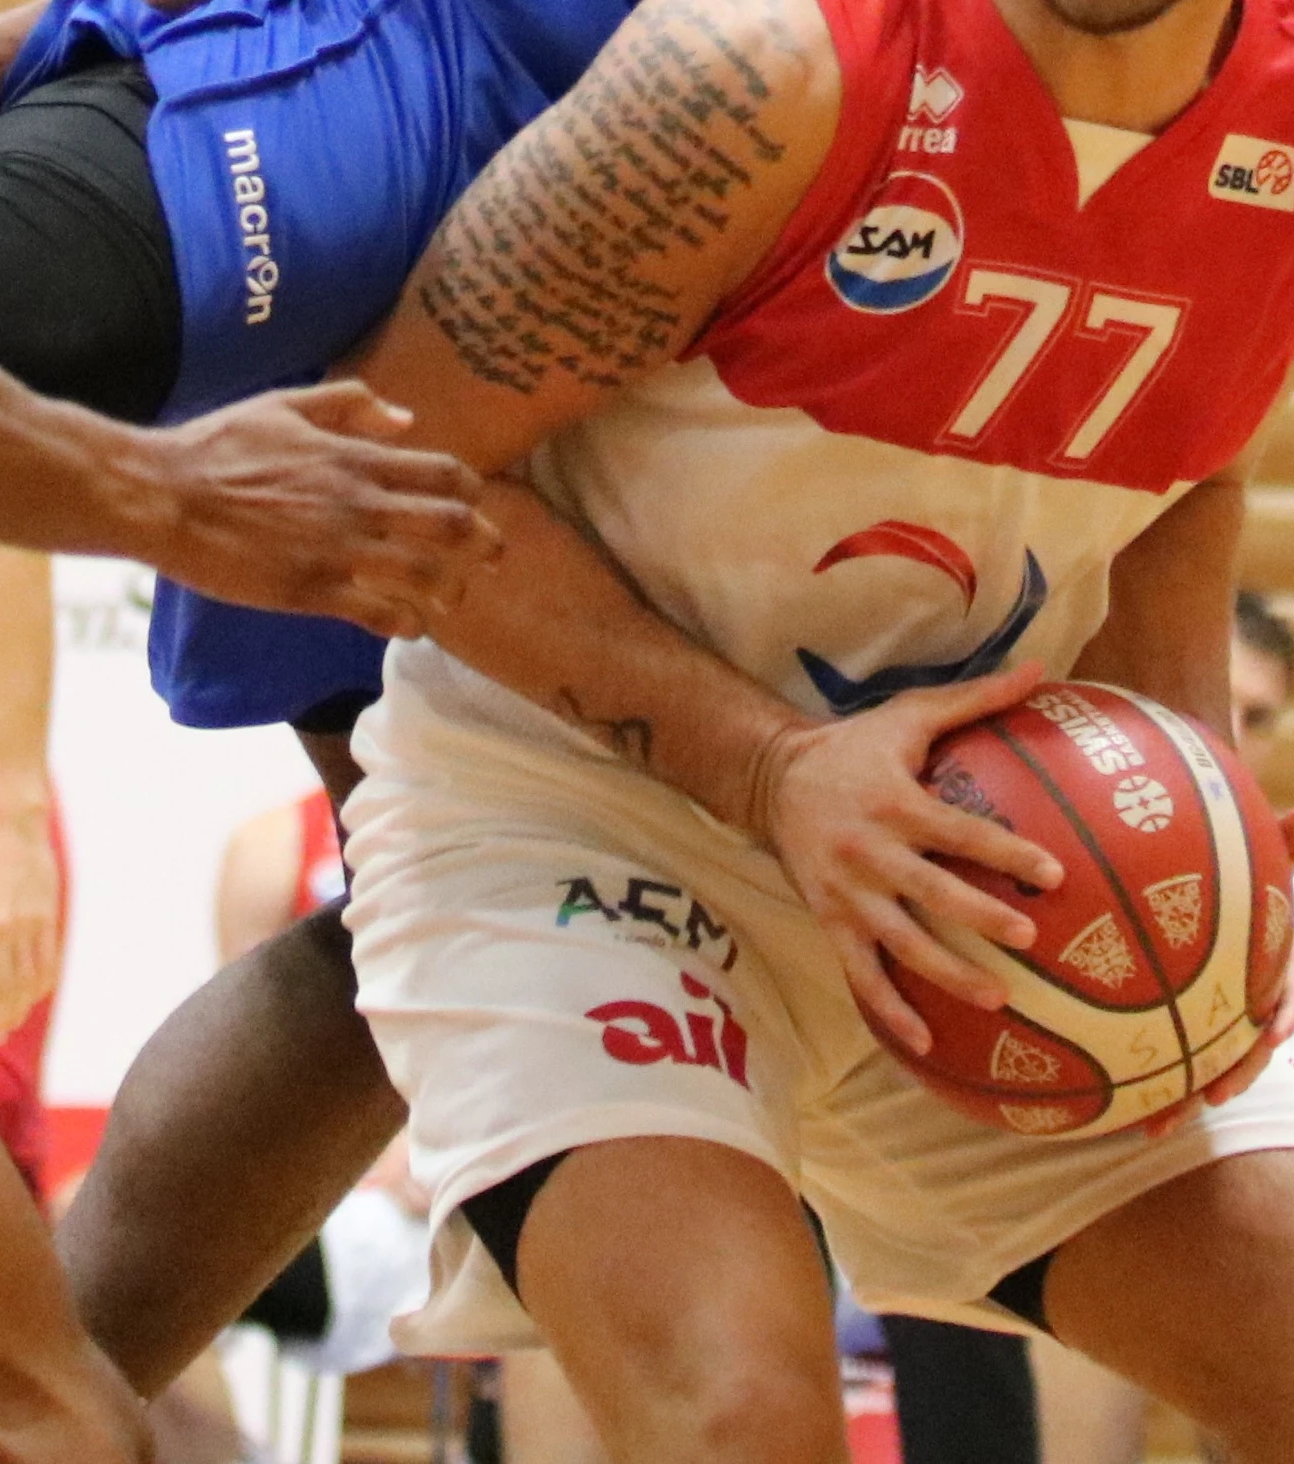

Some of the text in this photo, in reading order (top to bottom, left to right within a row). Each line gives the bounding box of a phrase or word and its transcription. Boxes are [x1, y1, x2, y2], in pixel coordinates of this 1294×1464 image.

[897, 124, 957, 154] rrea
[1214, 164, 1259, 195] SBL
[223, 129, 280, 326] macron
[847, 226, 936, 259] SAM
[936, 260, 1189, 468] 77
[1026, 693, 1128, 776] SWISS
